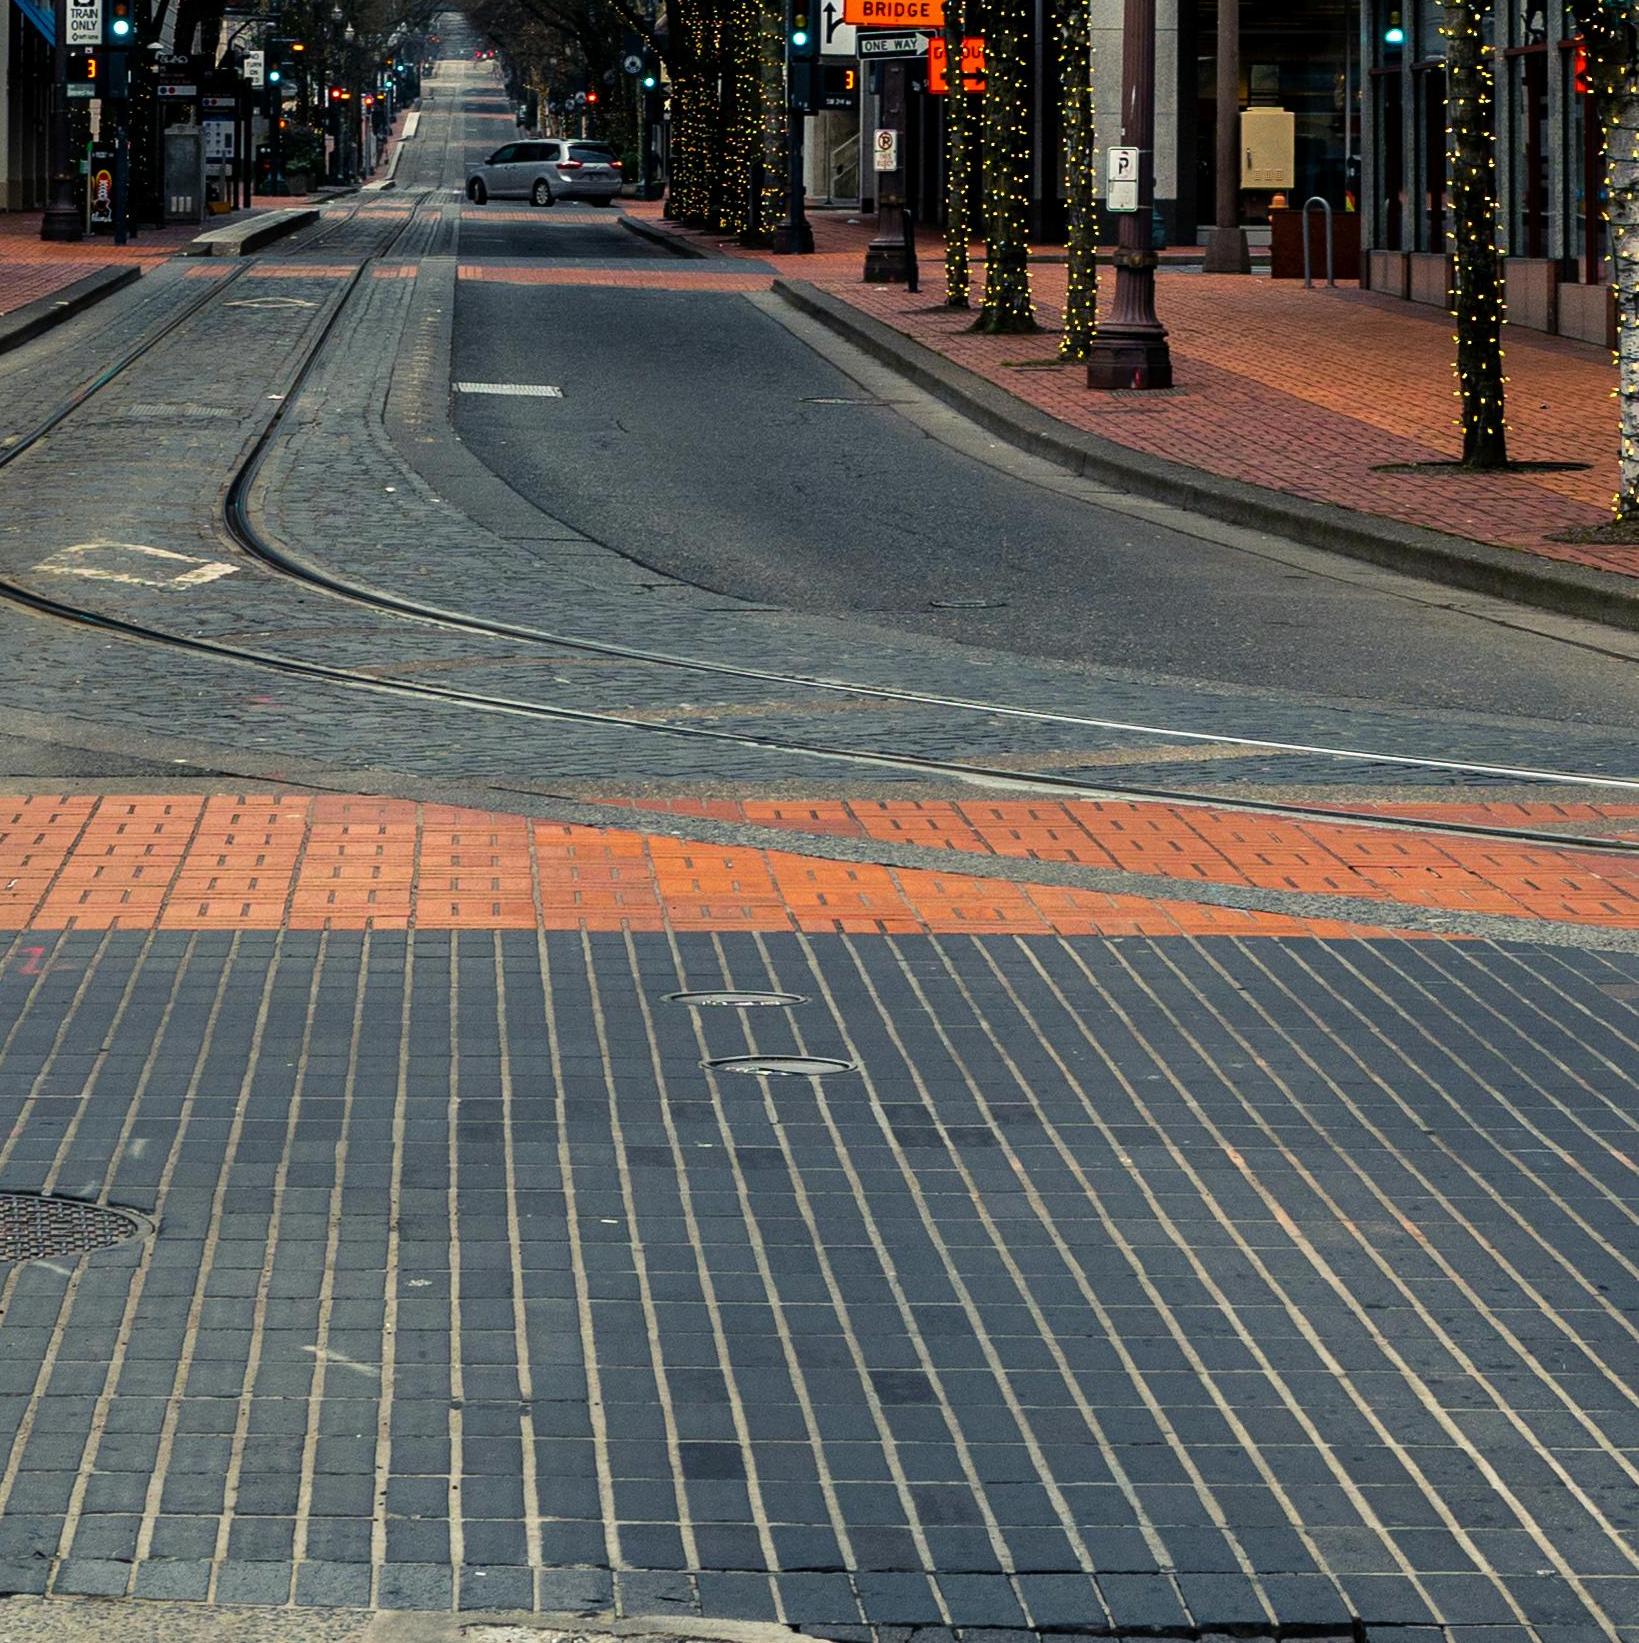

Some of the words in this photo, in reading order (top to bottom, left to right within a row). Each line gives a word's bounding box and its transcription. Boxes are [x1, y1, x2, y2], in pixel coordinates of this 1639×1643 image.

[71, 8, 99, 19] TRAIN
[863, 1, 930, 18] BRIDGE
[71, 20, 98, 31] ONLY
[864, 40, 888, 52] ONE
[894, 39, 918, 50] WAY
[845, 70, 854, 90] 3
